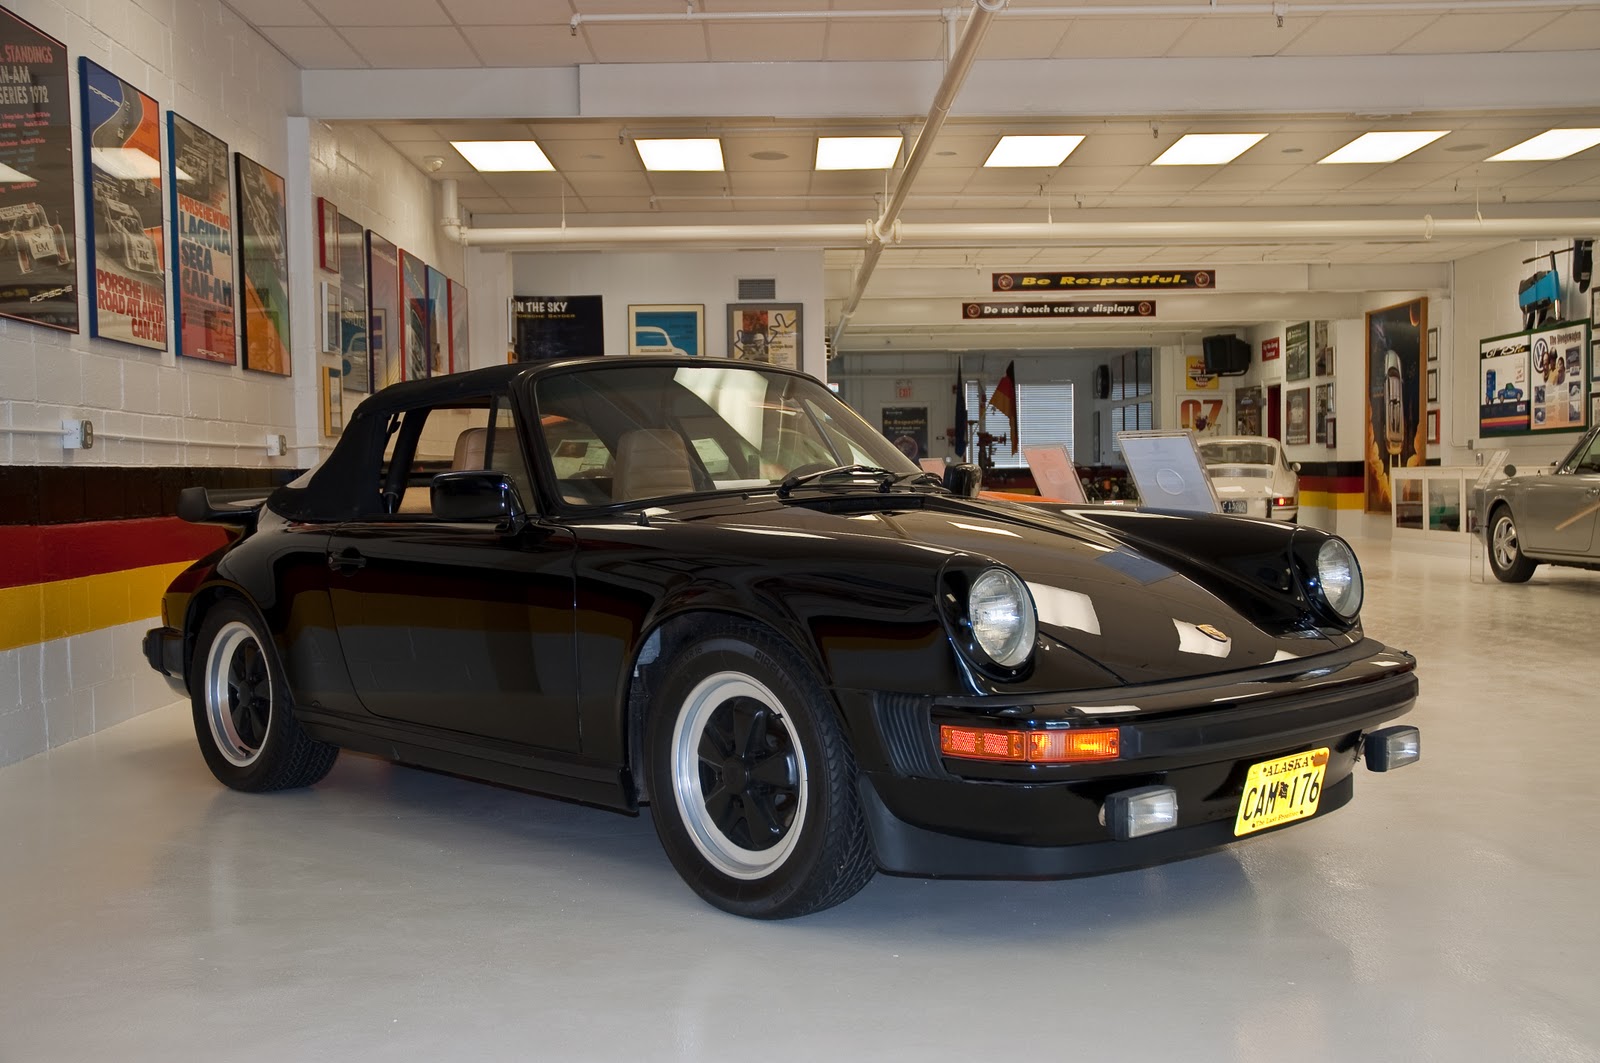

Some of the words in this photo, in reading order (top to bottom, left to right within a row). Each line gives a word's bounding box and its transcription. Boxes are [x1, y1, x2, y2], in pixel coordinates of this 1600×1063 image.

[5, 45, 53, 63] STANDINGS
[0, 65, 31, 84] N-AM
[0, 86, 28, 104] SERIES
[30, 85, 49, 104] 1972
[179, 193, 214, 225] PORSCHE
[180, 209, 232, 256] LAGUNA
[181, 239, 213, 277] SECA
[97, 269, 141, 301] PORSCHE
[182, 268, 233, 308] CAN-AM
[1022, 277, 1051, 286] Be
[1059, 275, 1188, 286] Respectful.
[98, 289, 125, 315] ROAD
[126, 301, 164, 324] ATLANTA
[526, 301, 545, 313] THE
[547, 301, 568, 313] SKY
[983, 306, 998, 314] Do
[1001, 306, 1019, 314] not
[1022, 305, 1050, 314] touch
[1092, 304, 1136, 314] displays
[131, 318, 165, 343] CAN-AM
[1265, 757, 1309, 777] ALASKA
[1243, 781, 1280, 821] CAM
[1289, 771, 1320, 809] 176
